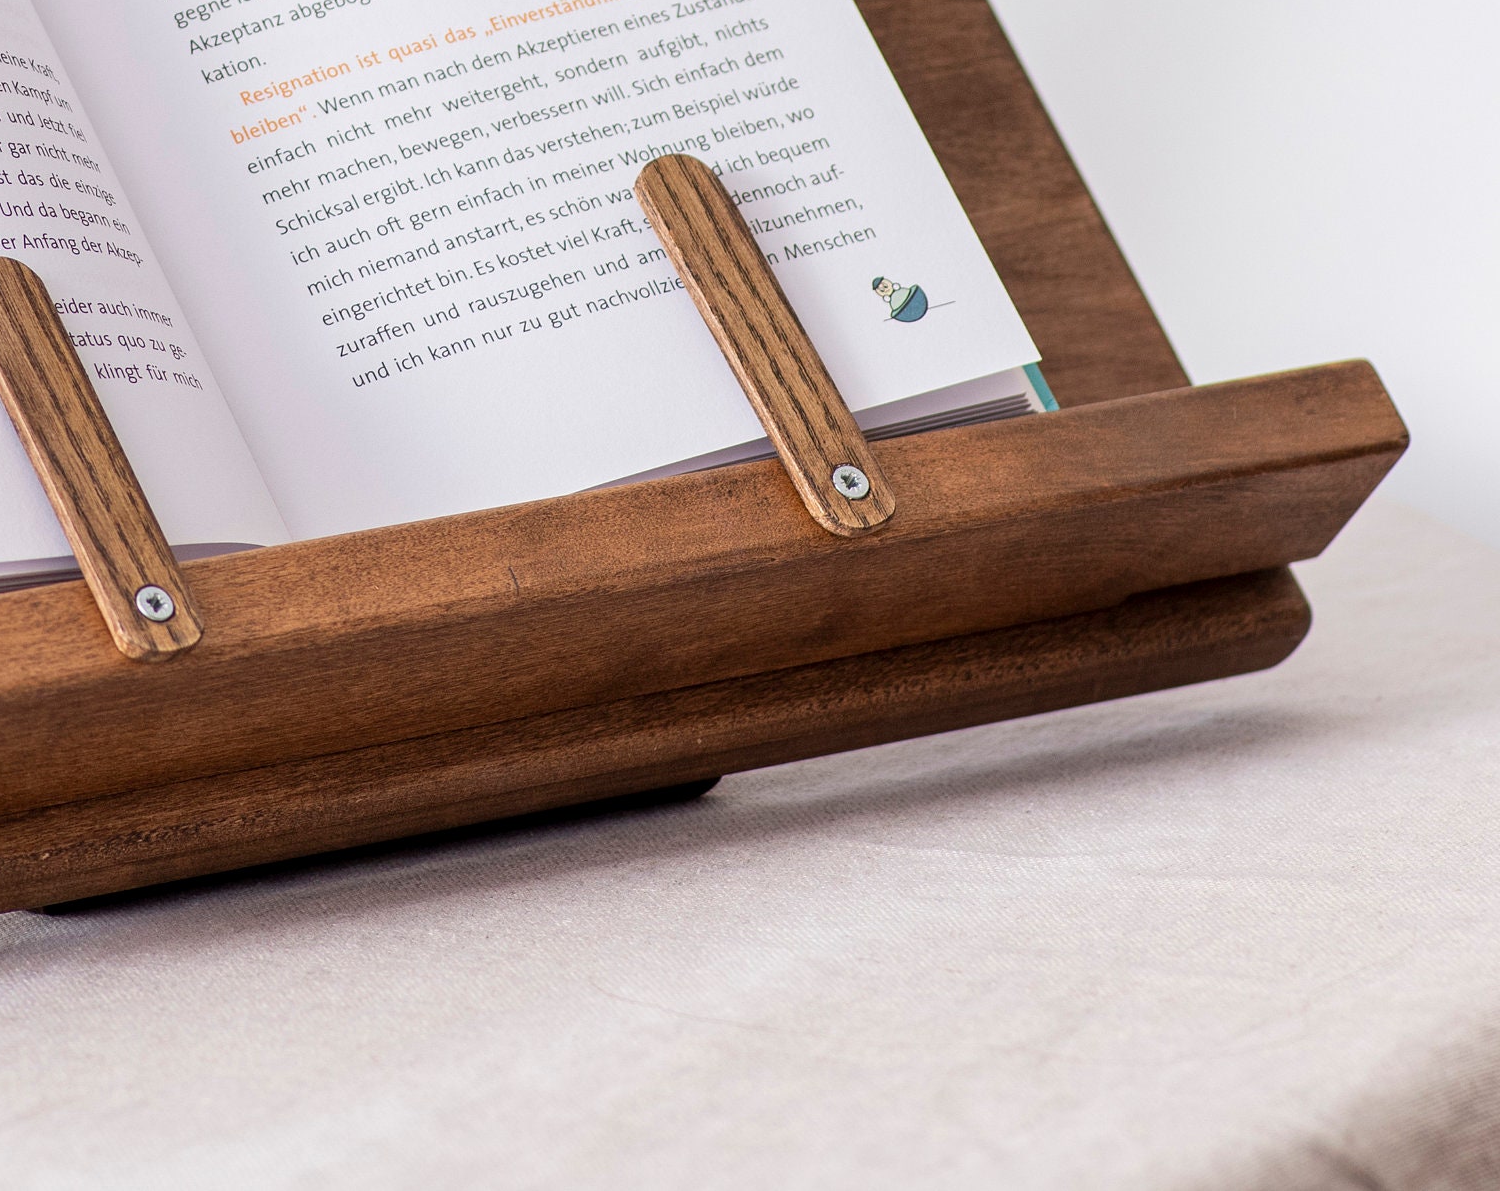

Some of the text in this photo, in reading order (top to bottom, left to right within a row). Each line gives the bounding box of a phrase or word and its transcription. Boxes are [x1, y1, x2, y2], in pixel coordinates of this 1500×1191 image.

[190, 14, 284, 55] Akzeptanz
[28, 58, 60, 84] Kraft,
[201, 57, 266, 84] kation.
[240, 63, 351, 106] Resignation
[356, 51, 381, 69] ist
[388, 34, 437, 62] quasi
[444, 27, 476, 44] das
[248, 19, 769, 174] einfach nicht mehr weitergeht, sondern aufgibt, nichts
[262, 48, 784, 204] mehr machen, bewegen, verbessern will. Sich einfach dem
[18, 170, 44, 186] das
[49, 173, 71, 190] die
[75, 180, 116, 206] einzige
[290, 108, 814, 265] ich auch oft gern einfach in meiner Wohnung bleiben, wo
[23, 233, 80, 255] Anfang
[81, 236, 102, 253] der
[106, 242, 143, 267] Akzep-
[352, 362, 390, 387] und
[394, 352, 424, 372] ich
[427, 338, 476, 361] kann
[482, 325, 512, 344] nur
[519, 317, 542, 332] zu
[548, 303, 581, 328] gut
[784, 228, 876, 260] Menschen
[94, 363, 143, 384] klingt
[146, 364, 167, 381] für
[173, 372, 203, 390] mich
